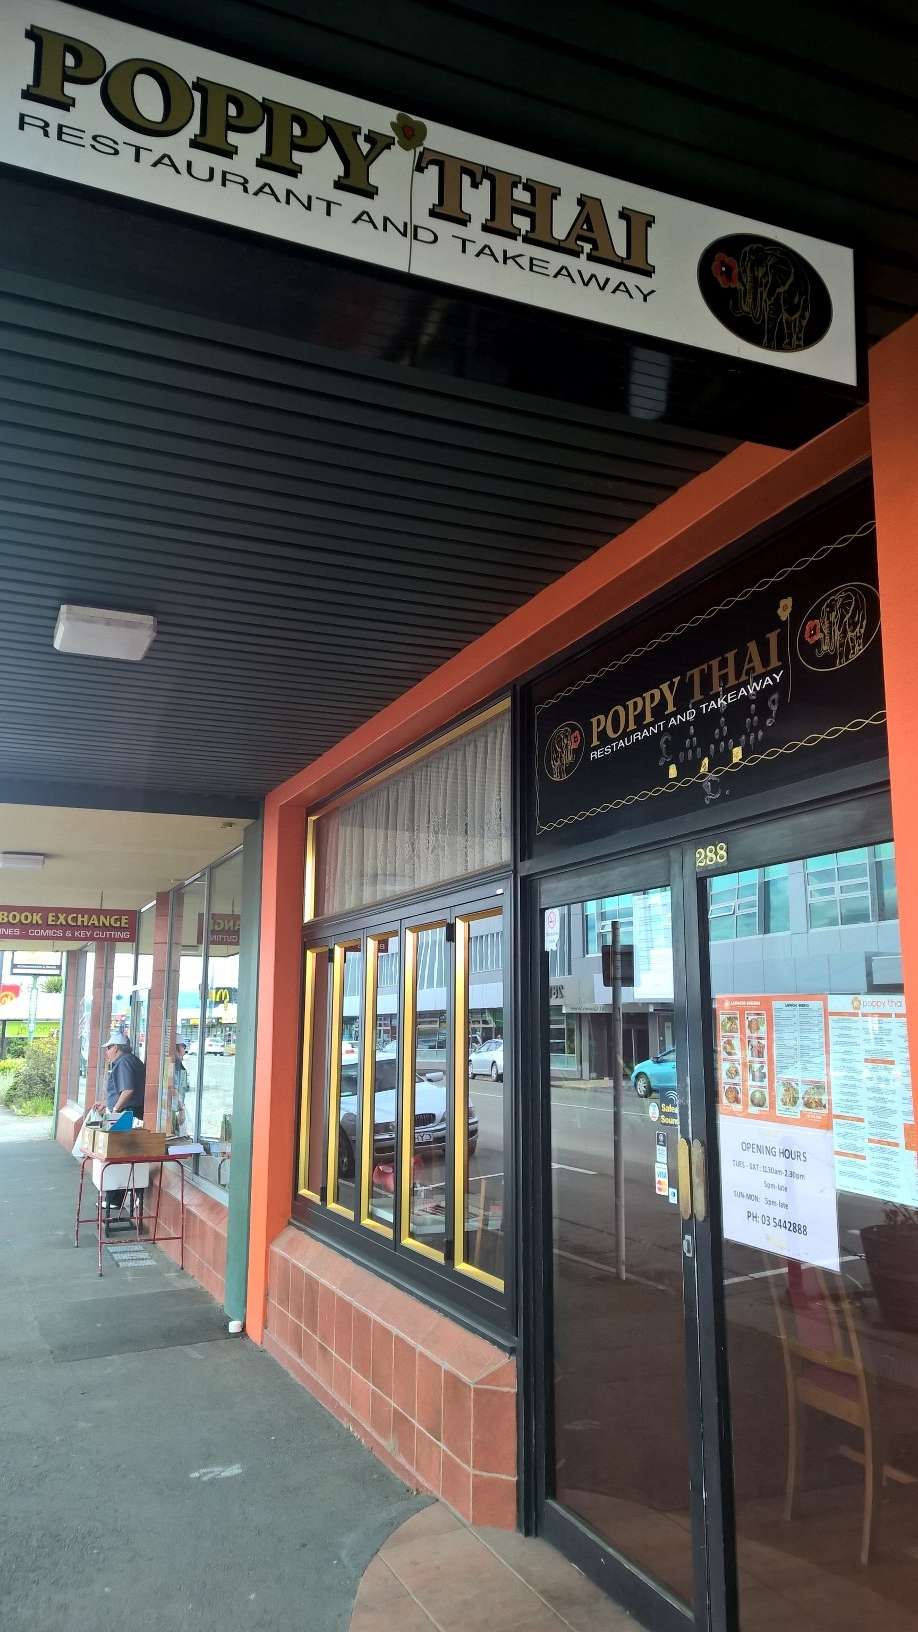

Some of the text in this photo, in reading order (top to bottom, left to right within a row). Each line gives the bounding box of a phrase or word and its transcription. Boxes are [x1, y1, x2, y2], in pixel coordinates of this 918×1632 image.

[21, 24, 655, 278] POPPY THAI
[18, 112, 656, 303] RESTAURANT AND TAKEAWAY
[590, 628, 783, 748] POPPY THAI
[590, 670, 785, 761] RESTAURANT AND TAKEAWAY
[695, 842, 728, 867] 288
[0, 911, 129, 928] BOOK EXCHANGE
[28, 929, 63, 937] COMICS
[74, 930, 92, 938] KEY
[741, 1141, 808, 1162] OPENING HOURS
[747, 1210, 808, 1236] PH: 03 5442888
